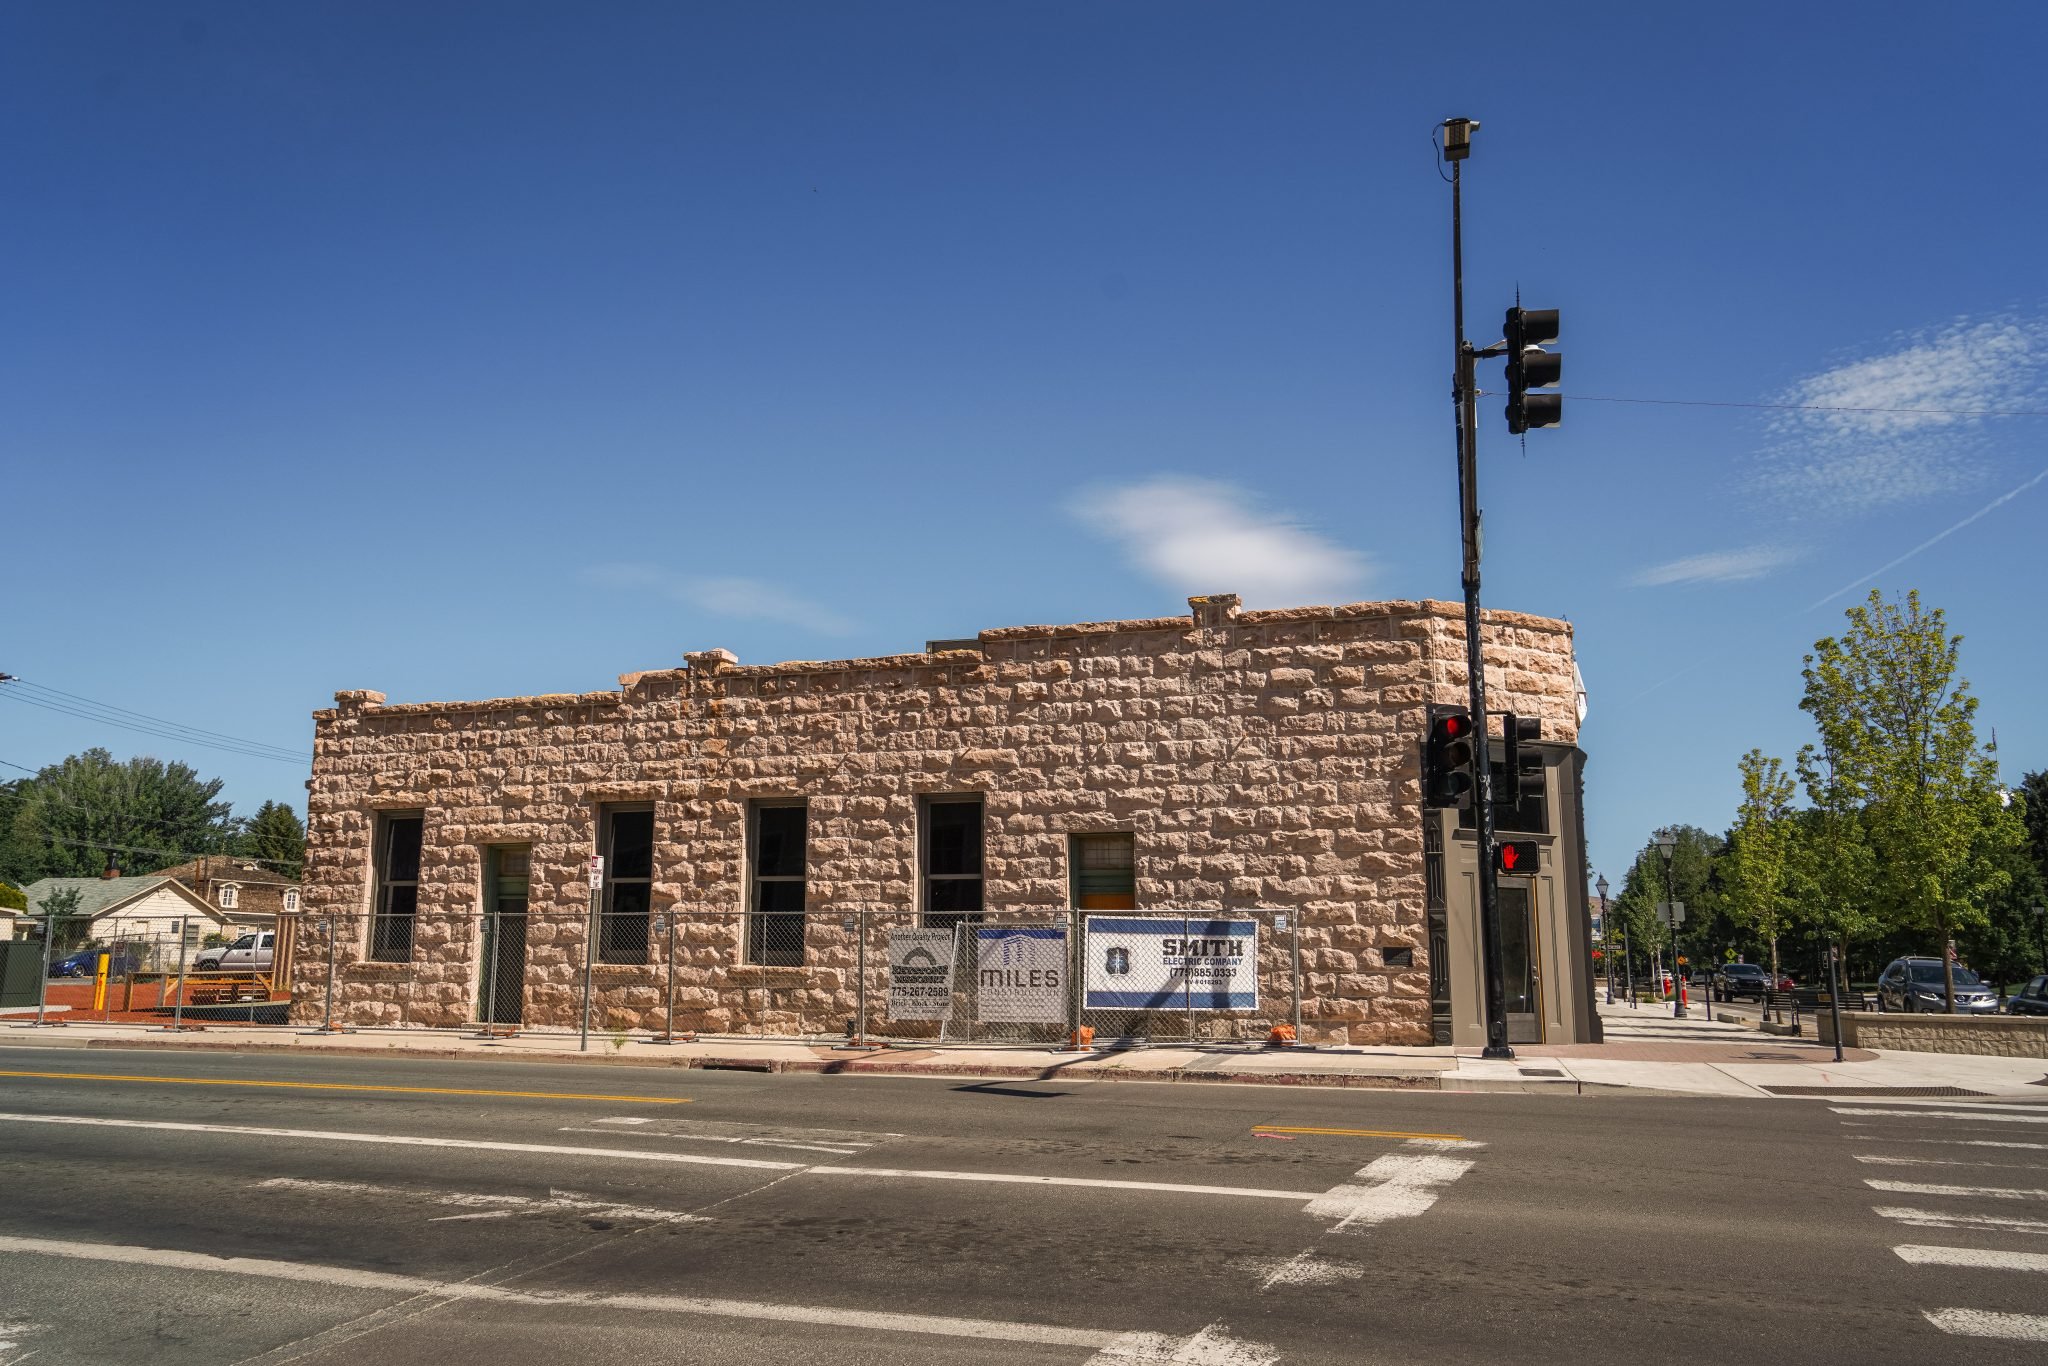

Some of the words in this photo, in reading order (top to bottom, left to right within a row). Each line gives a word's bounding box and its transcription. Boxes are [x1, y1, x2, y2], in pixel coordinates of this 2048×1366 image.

[912, 932, 930, 942] Quality
[932, 933, 950, 942] Project
[1163, 939, 1243, 956] SMITH
[1164, 958, 1202, 966] ELECTRIC
[980, 969, 1058, 987] MILES
[1170, 968, 1236, 978] (775)885.0333
[892, 986, 948, 996] 775-267-2589
